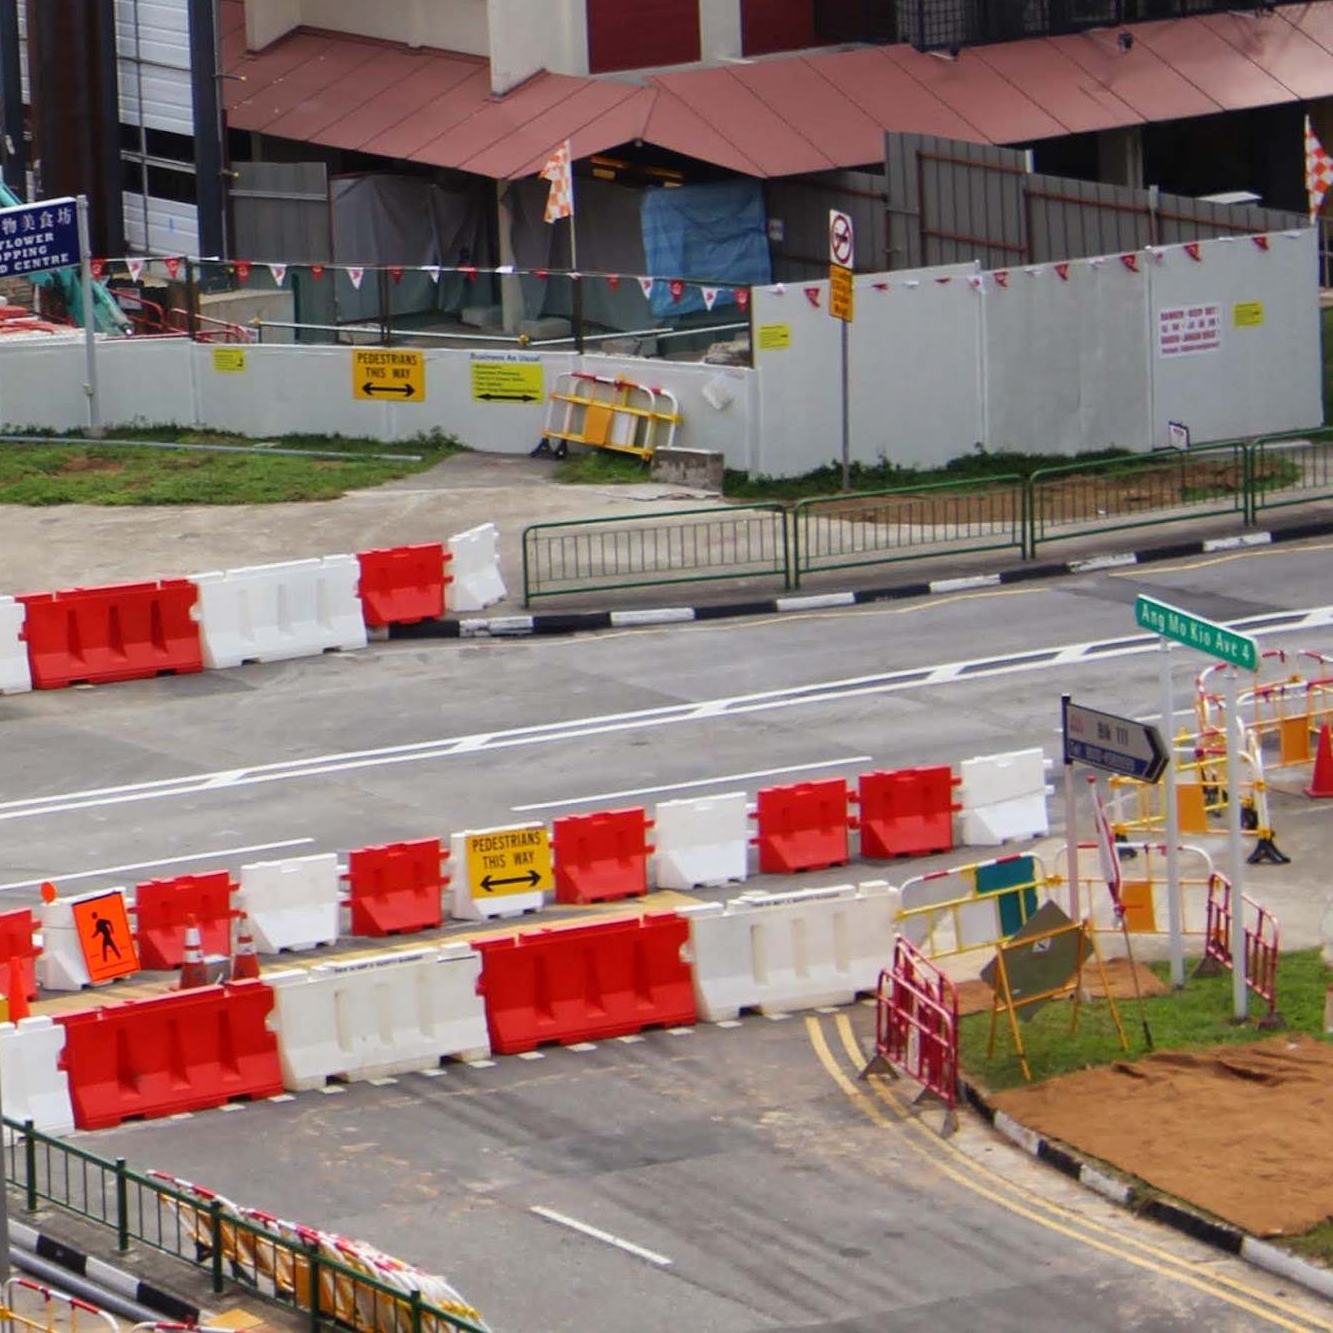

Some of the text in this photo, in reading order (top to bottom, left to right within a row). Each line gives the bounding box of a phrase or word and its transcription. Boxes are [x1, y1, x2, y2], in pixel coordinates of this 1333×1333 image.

[14, 253, 69, 271] CENTRE
[357, 353, 417, 366] PEDESTRIANS
[366, 367, 410, 379] THIS WAY
[1141, 603, 1250, 661] Ang Mo Kio Ave 4
[472, 831, 541, 852] PEDESTRIANS
[482, 851, 534, 869] THIS WAY
